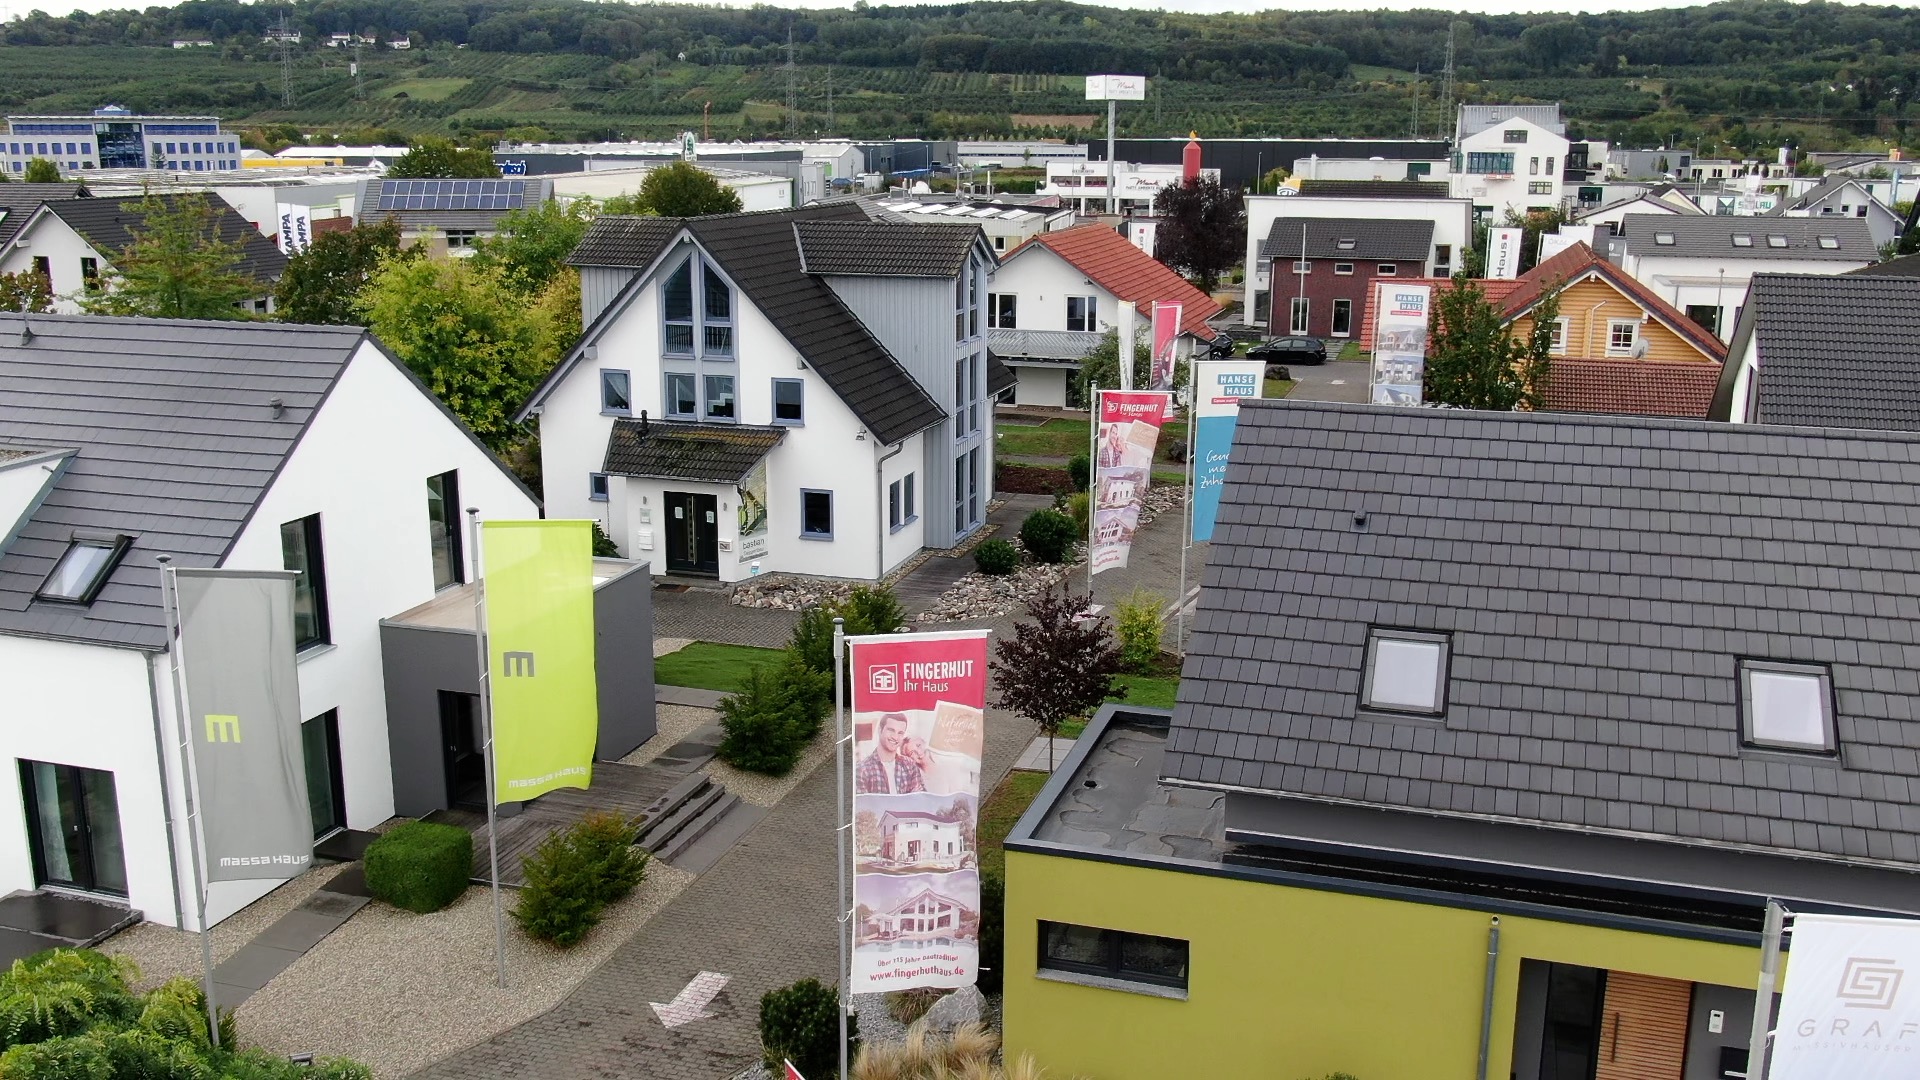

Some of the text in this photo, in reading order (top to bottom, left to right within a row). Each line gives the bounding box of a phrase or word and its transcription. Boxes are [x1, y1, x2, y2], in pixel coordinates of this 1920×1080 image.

[1738, 201, 1772, 209] SLAU
[296, 216, 308, 254] AMPA
[1496, 242, 1508, 277] Haus
[1220, 375, 1254, 384] HANSE
[1226, 387, 1253, 395] HAUS
[1120, 404, 1159, 412] FINGERHUT
[743, 538, 765, 551] bastian
[903, 660, 973, 680] FINGERHUT
[904, 680, 949, 692] Ihr Haus
[508, 773, 554, 788] massa
[220, 856, 271, 867] massa
[870, 965, 965, 981] www.fingerhuthaus.de
[1797, 1018, 1919, 1040] GRAF
